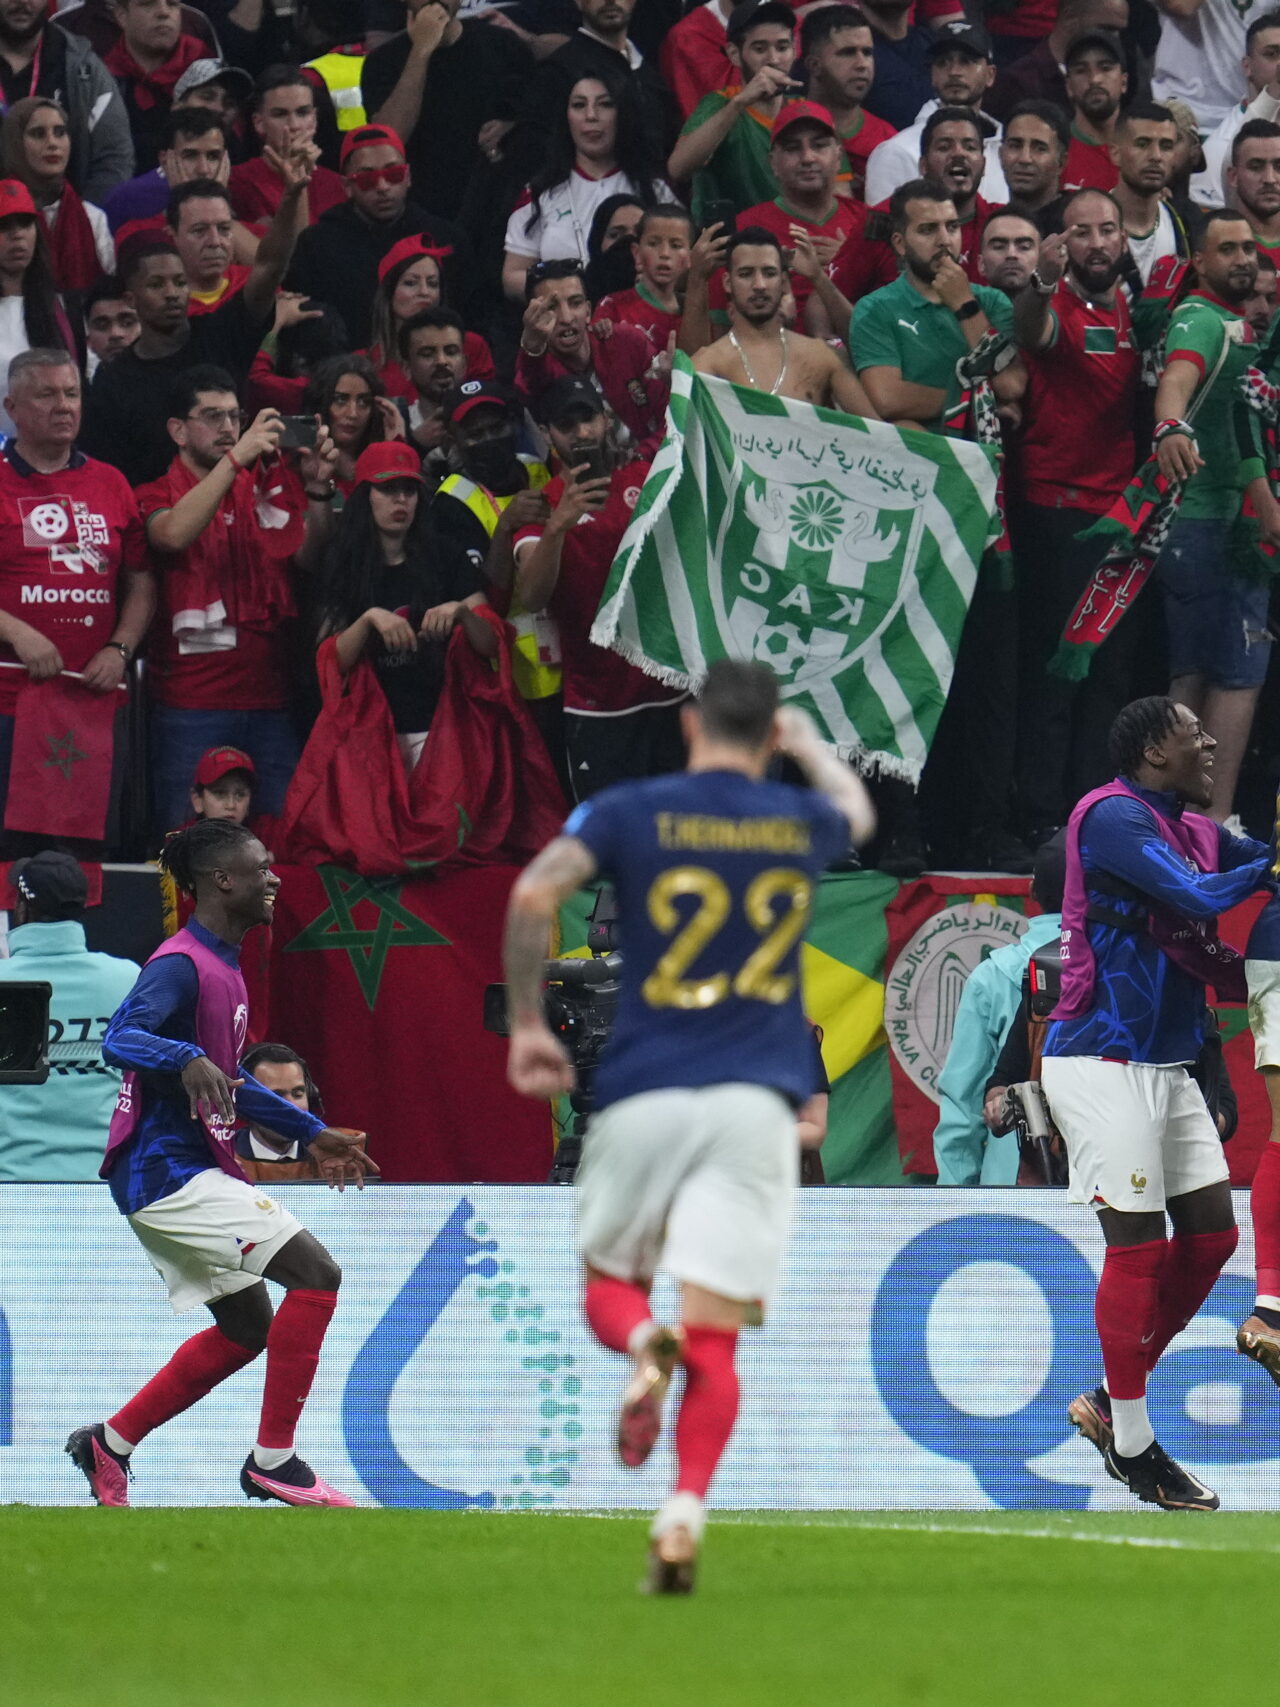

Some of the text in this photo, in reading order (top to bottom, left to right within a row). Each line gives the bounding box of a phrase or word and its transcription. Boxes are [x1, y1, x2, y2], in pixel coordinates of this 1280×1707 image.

[20, 584, 111, 604] Morocco
[643, 865, 810, 1009] 22
[892, 1019, 920, 1065] RAJA
